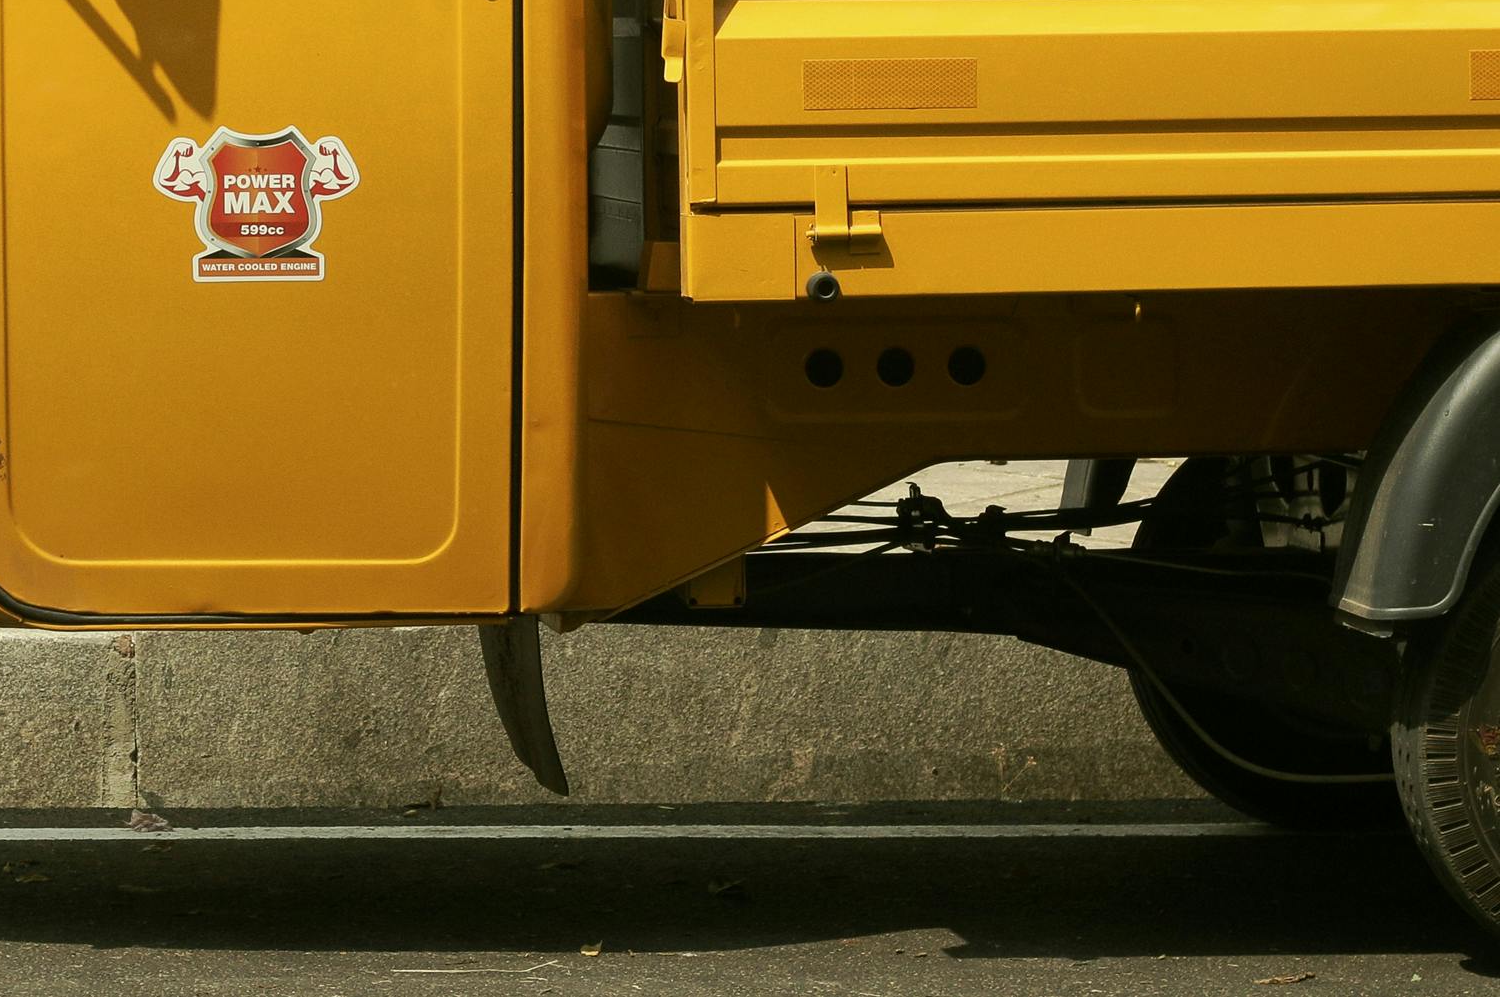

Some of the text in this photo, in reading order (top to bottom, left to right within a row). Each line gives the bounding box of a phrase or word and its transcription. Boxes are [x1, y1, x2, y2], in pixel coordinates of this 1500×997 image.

[223, 174, 295, 189] POWER
[223, 191, 296, 214] MAX
[240, 224, 285, 236] 599cc
[202, 262, 317, 272] WATER COOLED ENGINE
